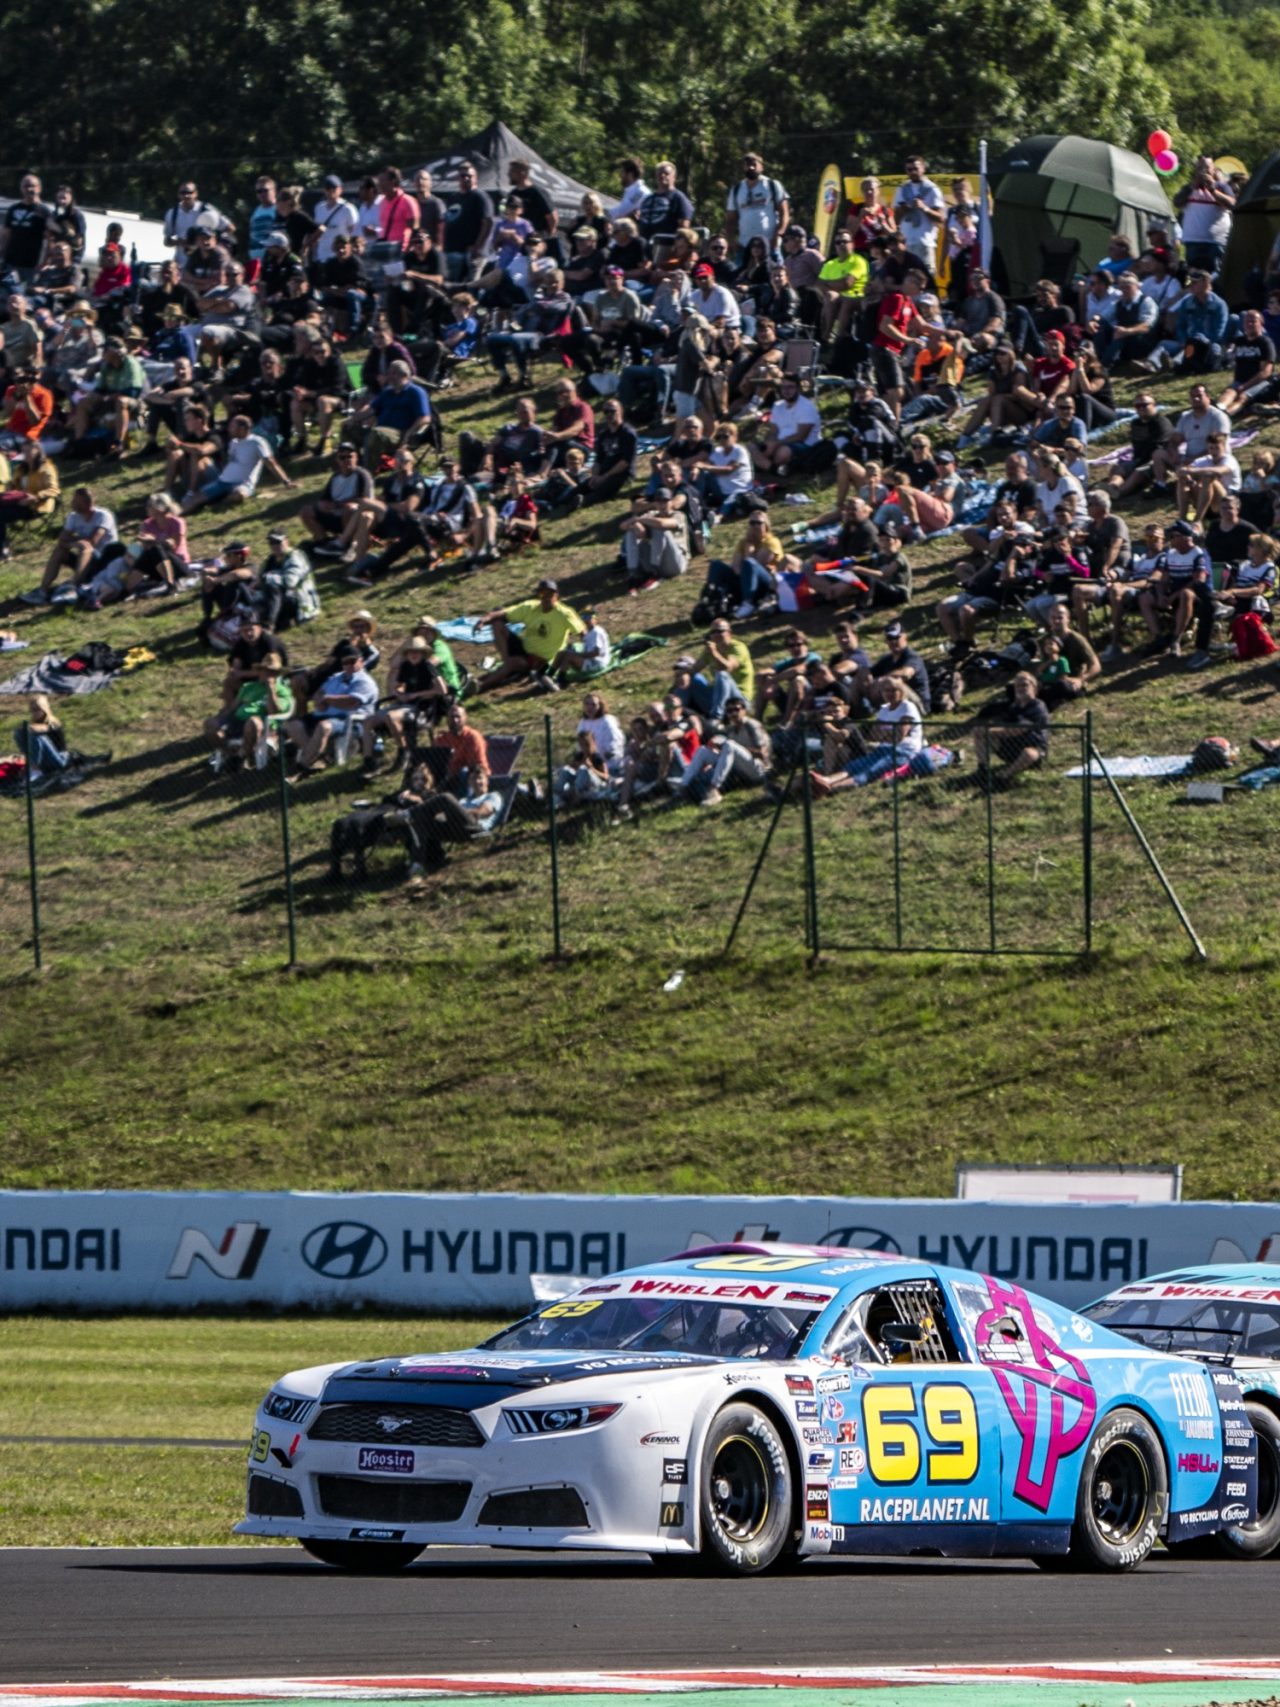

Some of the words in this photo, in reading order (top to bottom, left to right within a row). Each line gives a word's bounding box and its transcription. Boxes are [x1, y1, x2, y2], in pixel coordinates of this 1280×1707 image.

[403, 1230, 625, 1274] HYUNDAI
[918, 1235, 1147, 1282] HYUNDAI
[629, 1280, 779, 1300] WHELEN
[539, 1300, 603, 1319] 69
[810, 1434, 832, 1443] MASTER
[861, 1381, 980, 1487] 69
[360, 1450, 412, 1467] Hoosier
[807, 1489, 828, 1500] ENZO
[860, 1498, 990, 1522] RACEPLANET.NL
[1180, 1513, 1188, 1524] VG
[1189, 1510, 1218, 1522] RECYCLING
[811, 1526, 832, 1539] Mobil
